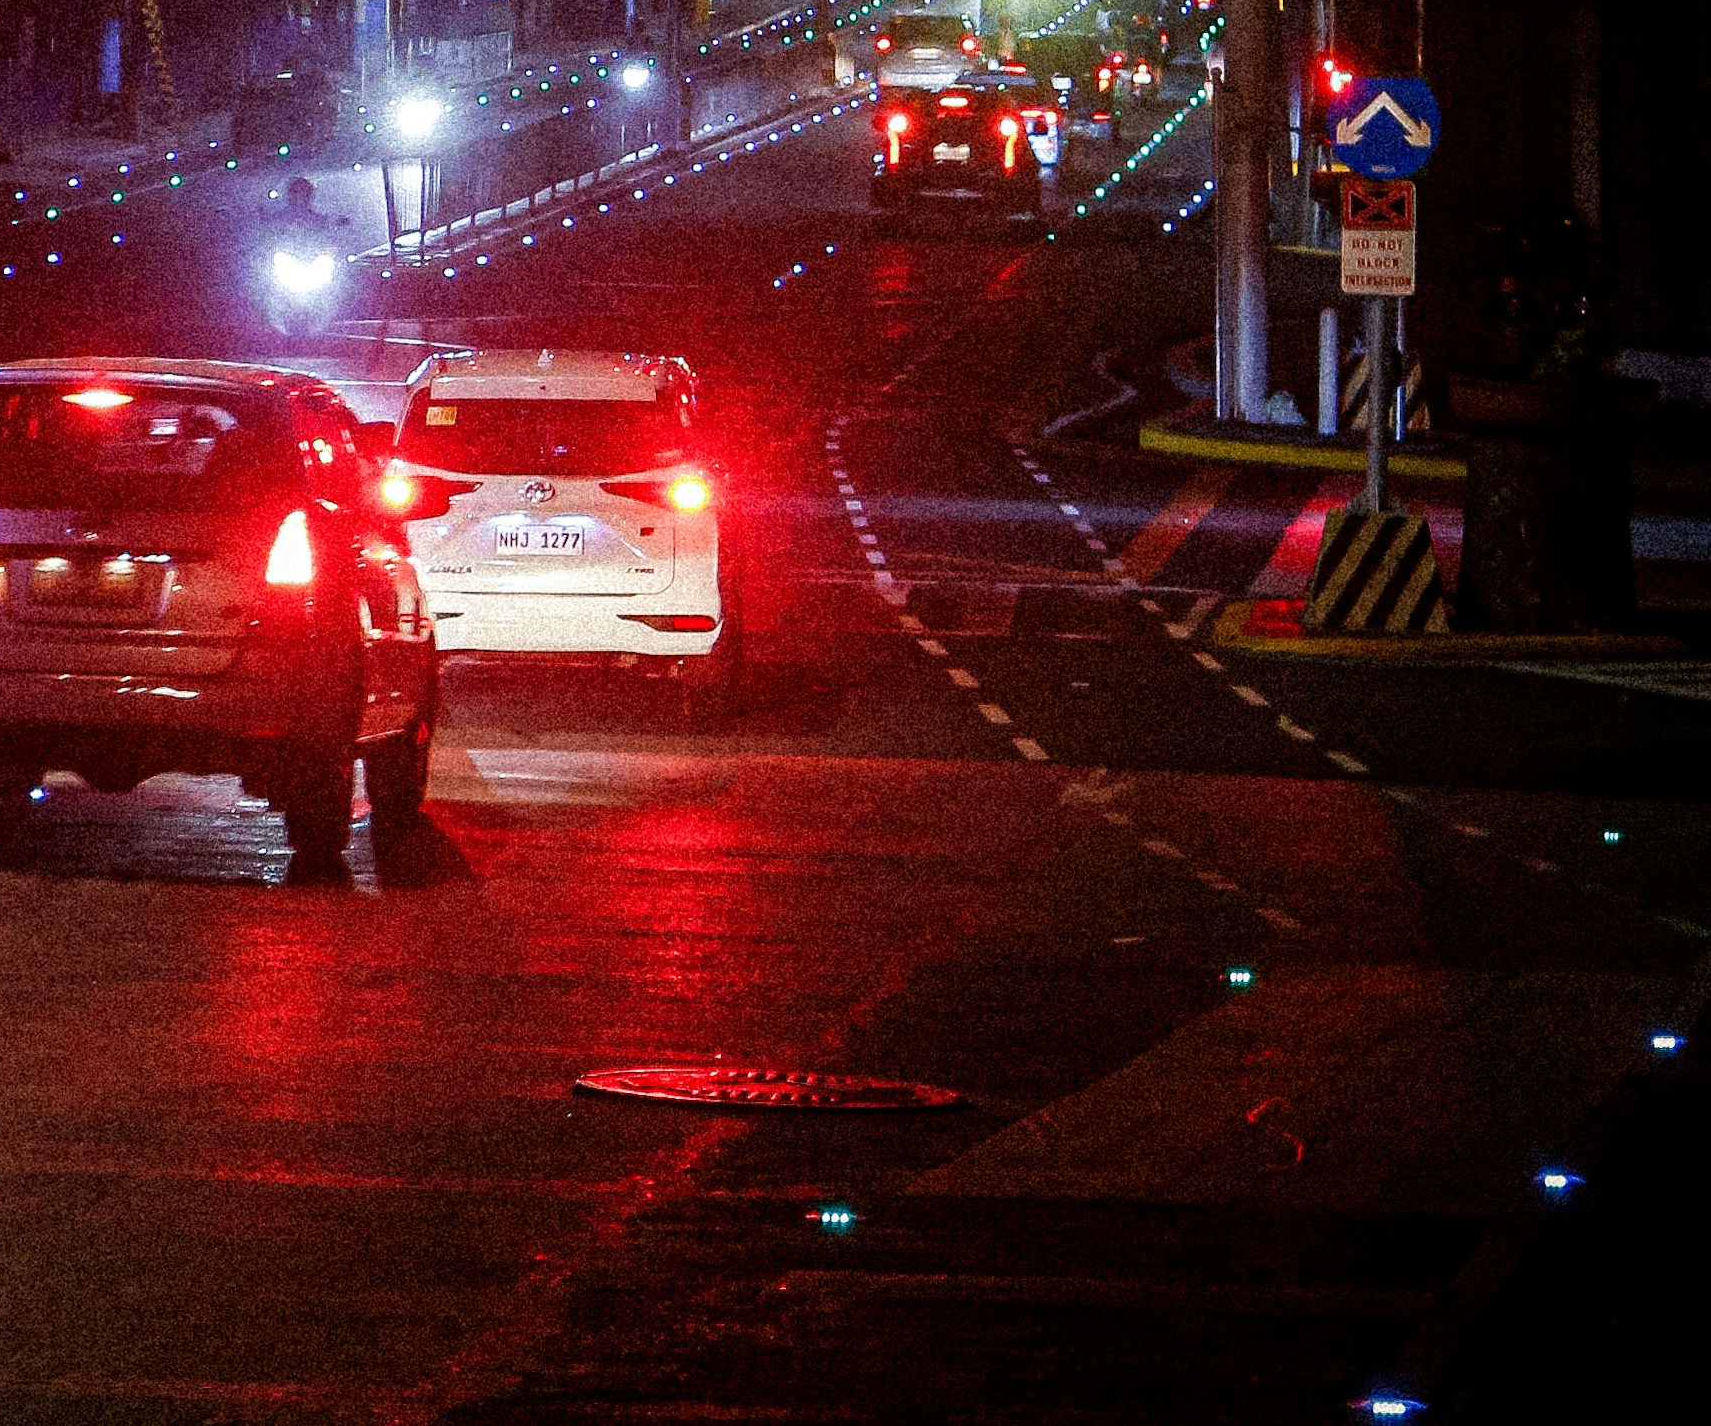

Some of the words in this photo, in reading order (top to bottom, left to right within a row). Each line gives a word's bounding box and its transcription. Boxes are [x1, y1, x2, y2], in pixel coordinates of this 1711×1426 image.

[1378, 239, 1404, 251] NOT
[1358, 258, 1399, 269] BLOCK
[500, 532, 529, 548] NHJ
[541, 532, 580, 548] 1277
